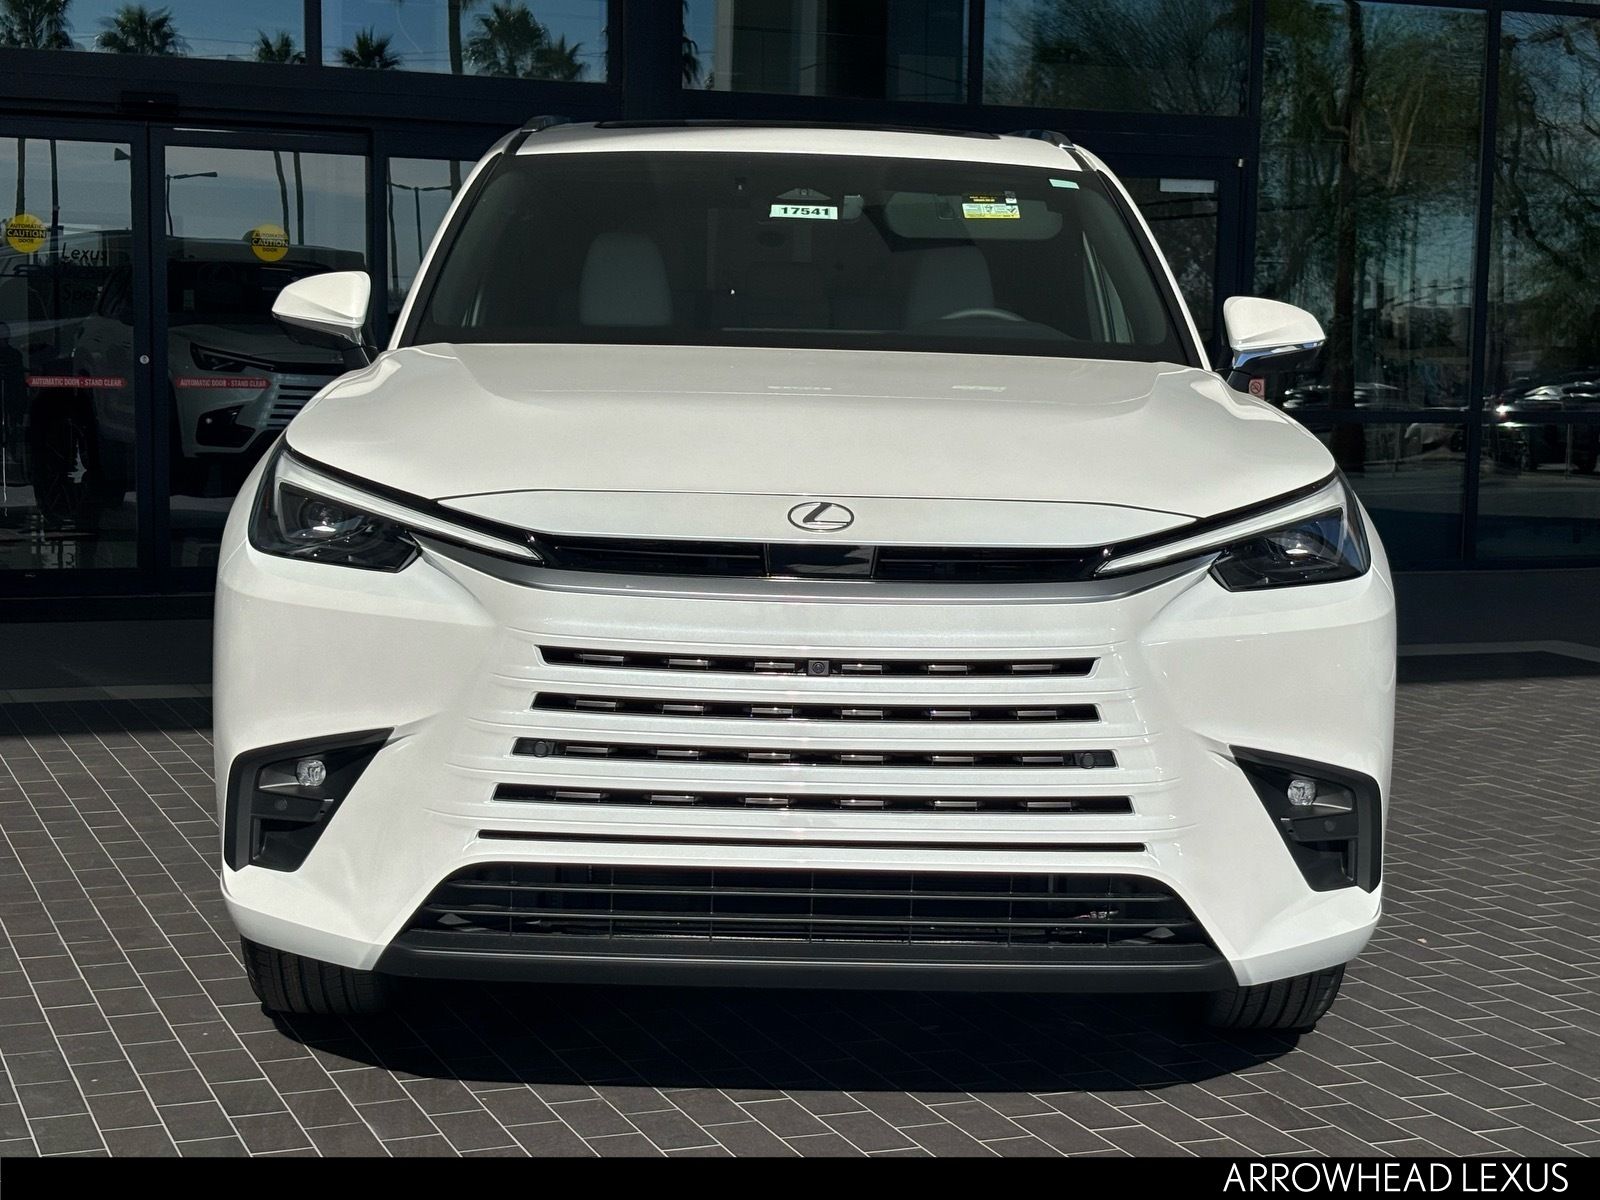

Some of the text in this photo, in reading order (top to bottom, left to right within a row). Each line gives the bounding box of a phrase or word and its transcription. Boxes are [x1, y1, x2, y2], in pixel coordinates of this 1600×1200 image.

[780, 206, 830, 216] 17541
[7, 229, 47, 238] CAUTION
[251, 238, 288, 247] CAUTION
[62, 241, 107, 260] Lexus
